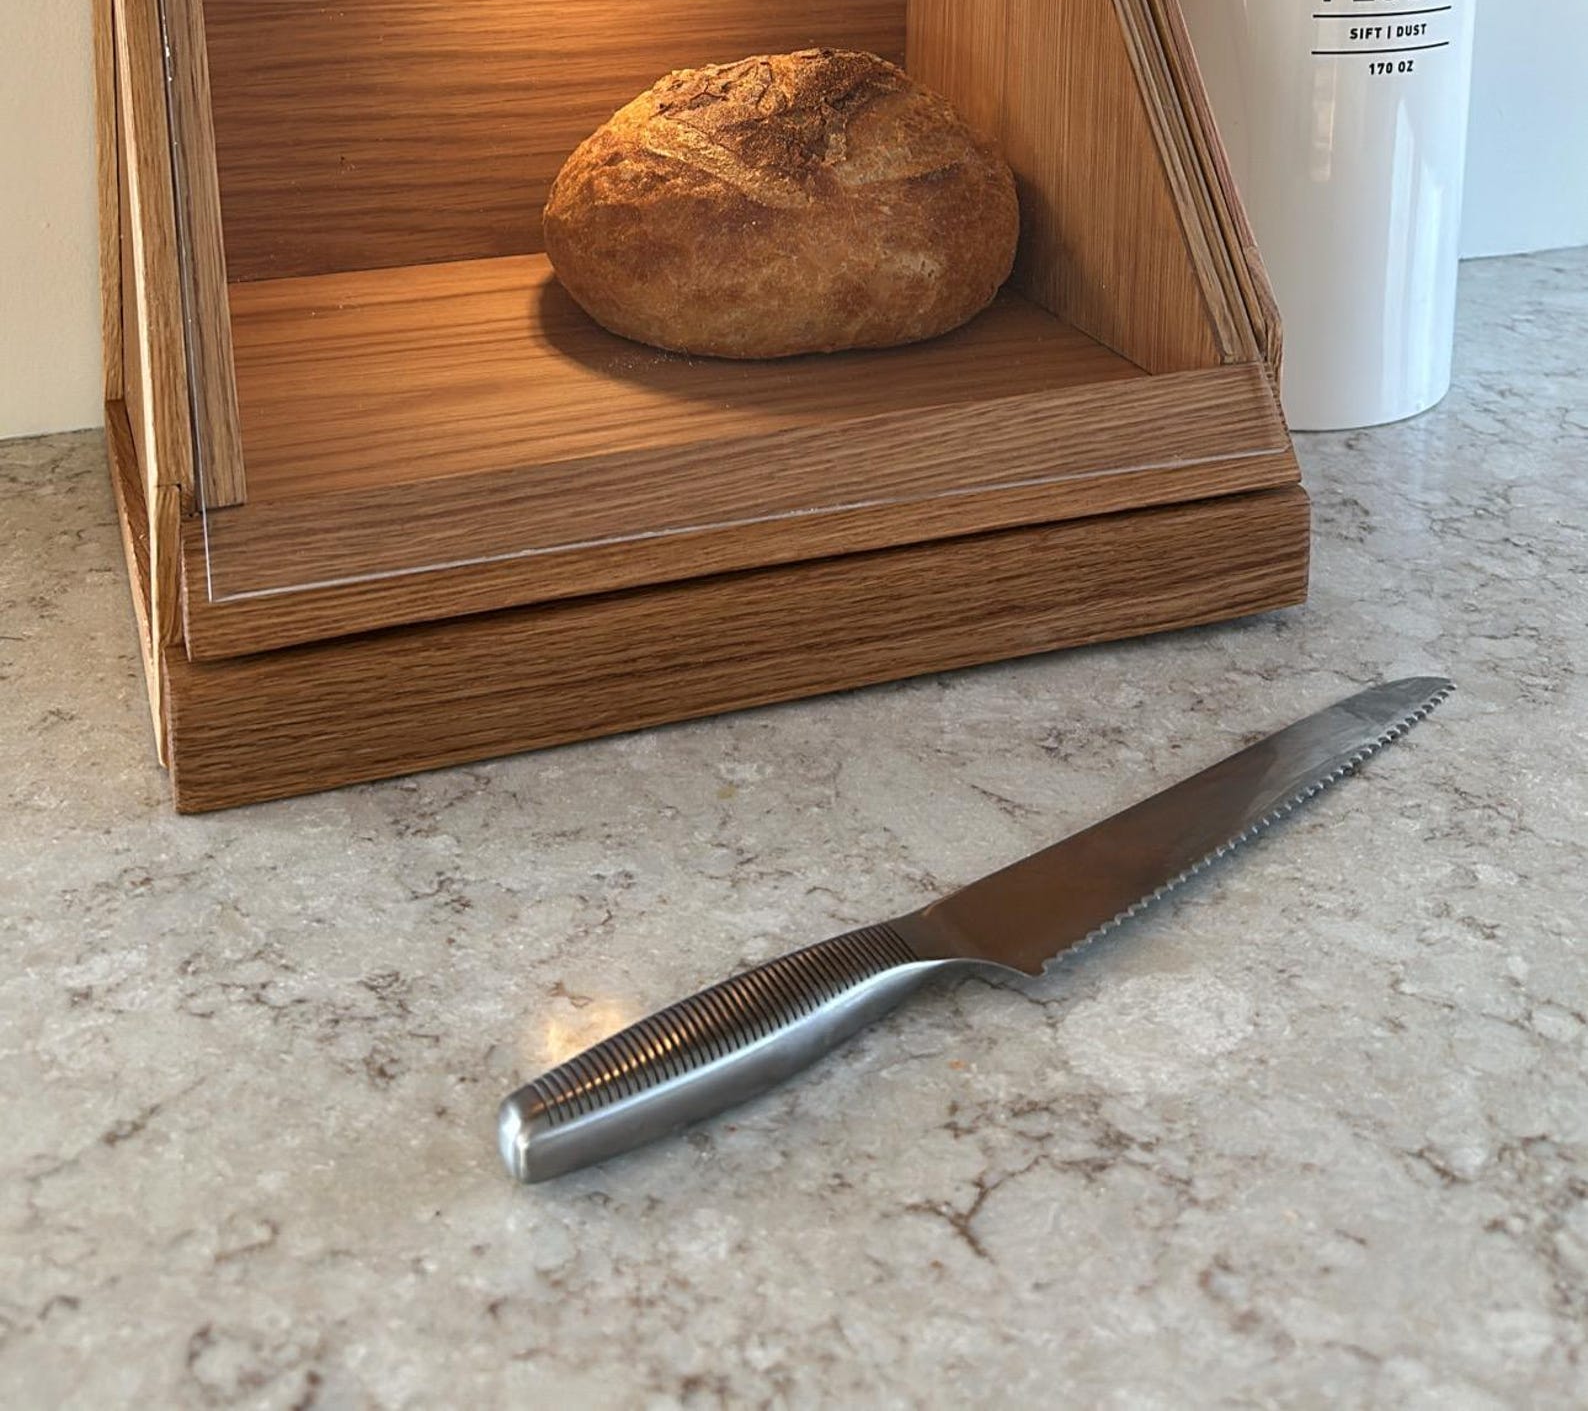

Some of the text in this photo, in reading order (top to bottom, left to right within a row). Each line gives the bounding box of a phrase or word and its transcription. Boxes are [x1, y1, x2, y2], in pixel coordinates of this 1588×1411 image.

[1350, 27, 1383, 40] SIFT
[1396, 23, 1427, 37] DUST
[1369, 60, 1414, 75] 170 OZ
